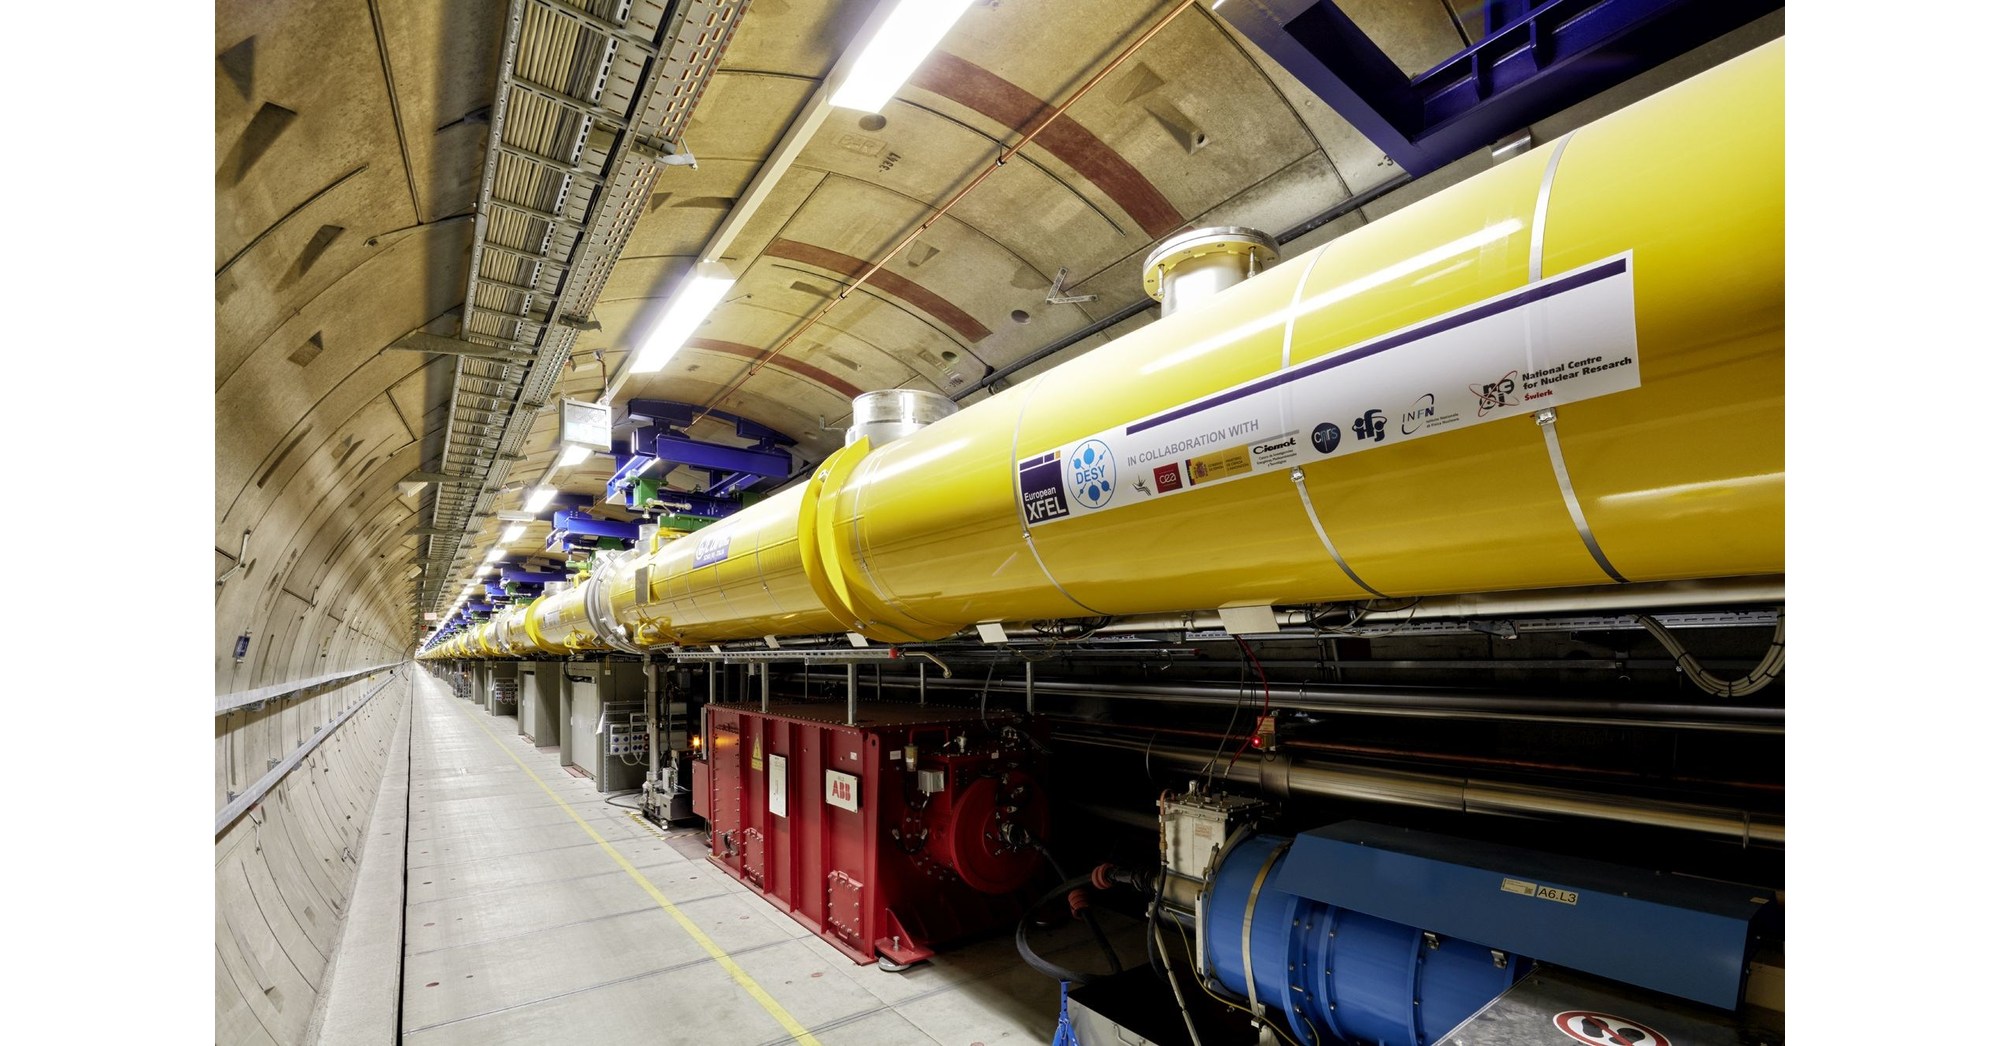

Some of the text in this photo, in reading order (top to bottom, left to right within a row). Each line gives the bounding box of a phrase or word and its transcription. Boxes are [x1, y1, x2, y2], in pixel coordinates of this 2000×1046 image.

[1522, 355, 1603, 382] National Centre
[1522, 356, 1633, 391] for Nuclear Research
[1401, 406, 1435, 424] INFN
[1127, 455, 1134, 467] IN
[1138, 428, 1227, 464] COLLABORATION
[1227, 418, 1260, 438] WITH
[1313, 426, 1338, 445] cnrs
[1075, 464, 1106, 485] DESY
[1159, 471, 1178, 484] cea
[1023, 486, 1057, 502] European
[1026, 496, 1067, 521] XFEL
[831, 779, 852, 802] ABB
[1538, 887, 1578, 903] A6.L3
